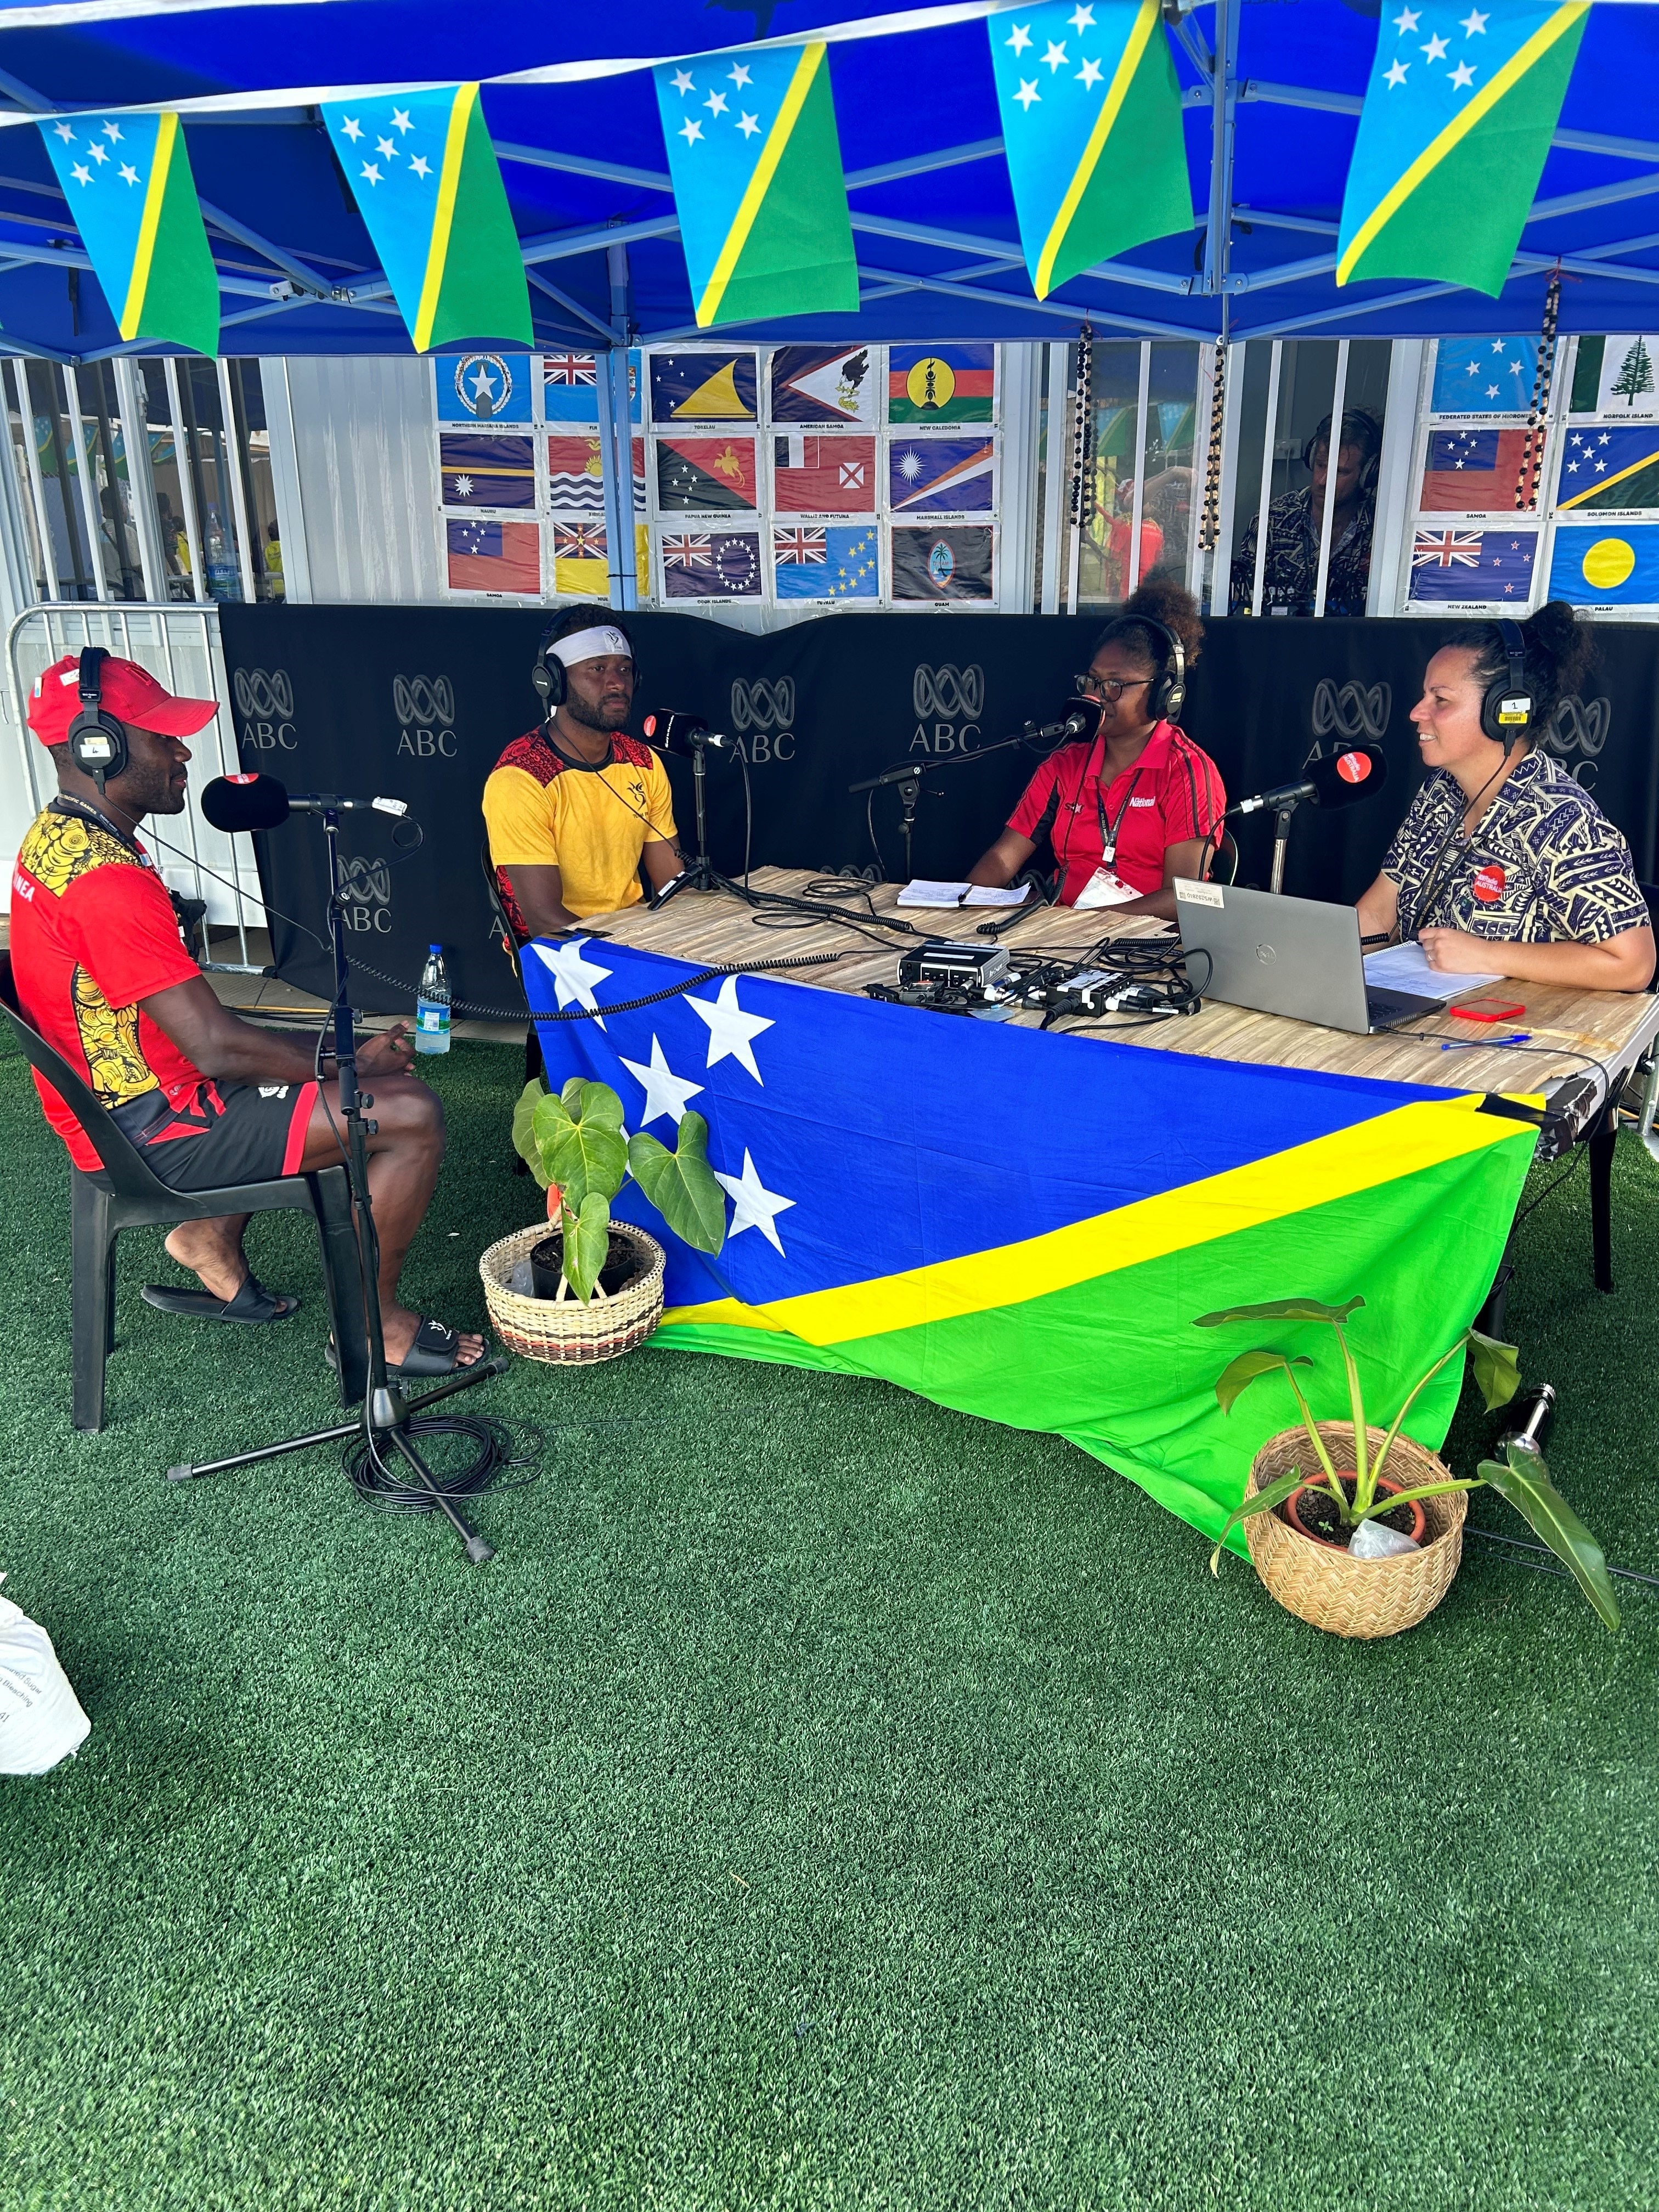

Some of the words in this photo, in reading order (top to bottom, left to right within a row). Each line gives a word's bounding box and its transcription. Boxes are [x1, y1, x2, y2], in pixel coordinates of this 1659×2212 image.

[241, 723, 298, 749] ABC
[397, 729, 458, 758] ABC
[729, 733, 795, 763] ABC
[909, 723, 981, 752] ABC
[1342, 754, 1360, 782] AUSTRALIA
[79, 801, 97, 815] GAMES
[1128, 795, 1156, 808] National
[1431, 882, 1444, 900] SOL2023
[1475, 881, 1502, 894] AUSTRALIA
[2, 1679, 33, 1708] Bleaching
[24, 1677, 43, 1695] Sugar
